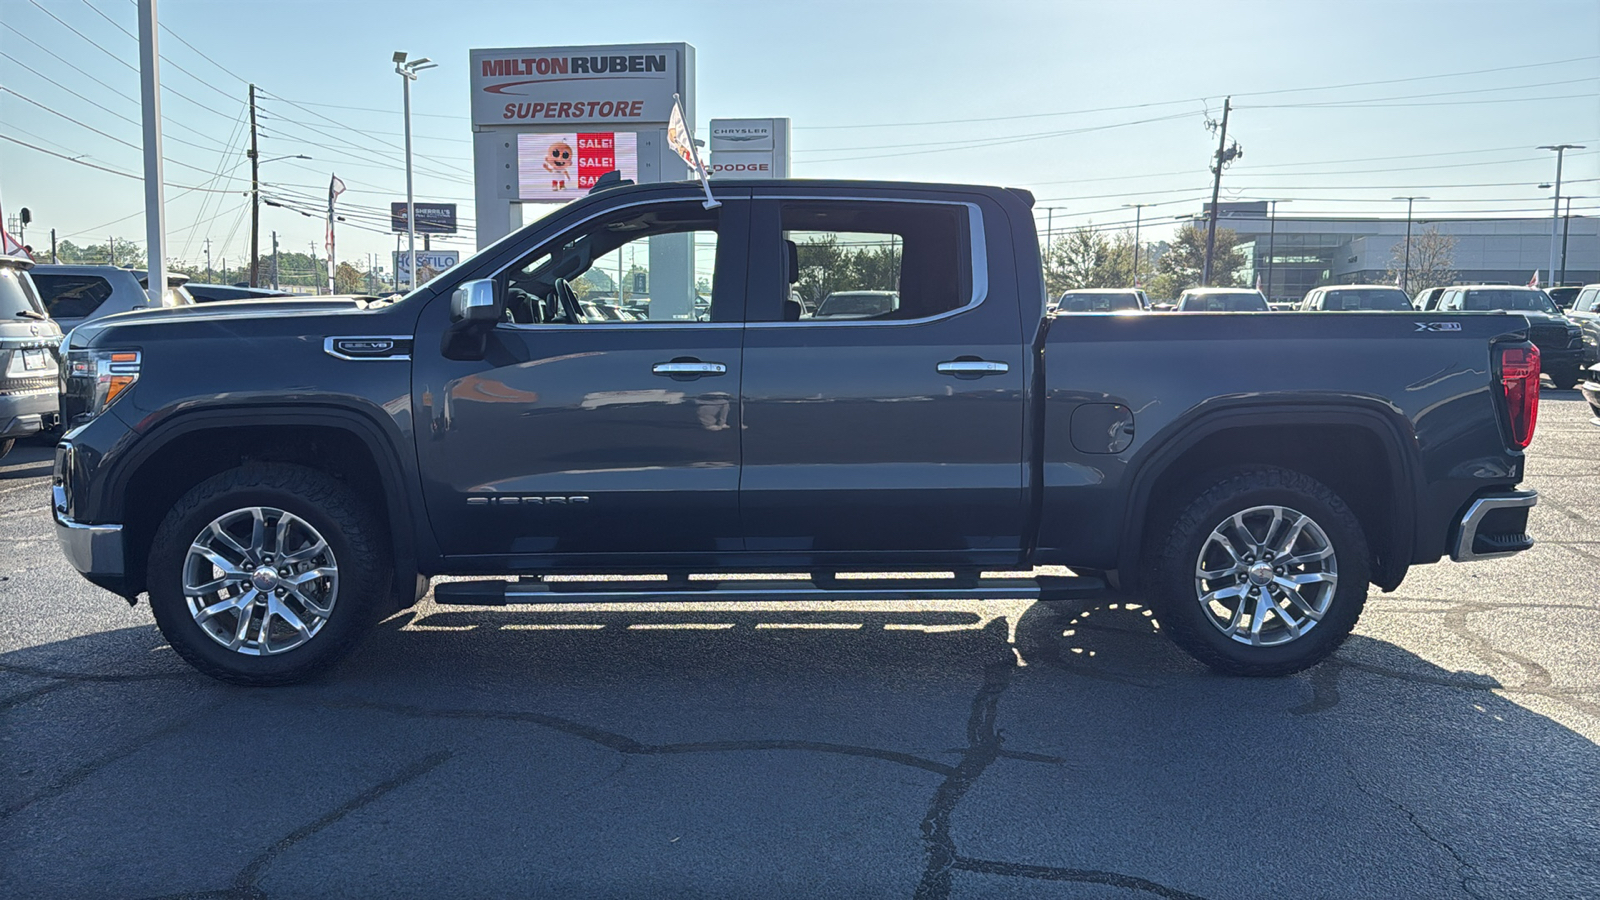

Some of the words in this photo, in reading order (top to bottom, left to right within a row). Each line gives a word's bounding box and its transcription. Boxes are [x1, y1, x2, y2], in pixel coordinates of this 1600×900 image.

[482, 57, 569, 77] MILTON
[571, 55, 666, 74] RUBEN
[503, 100, 644, 119] SUPERSTORE
[578, 139, 613, 149] SALE!
[579, 157, 613, 167] SALE!
[713, 163, 769, 172] DODGE
